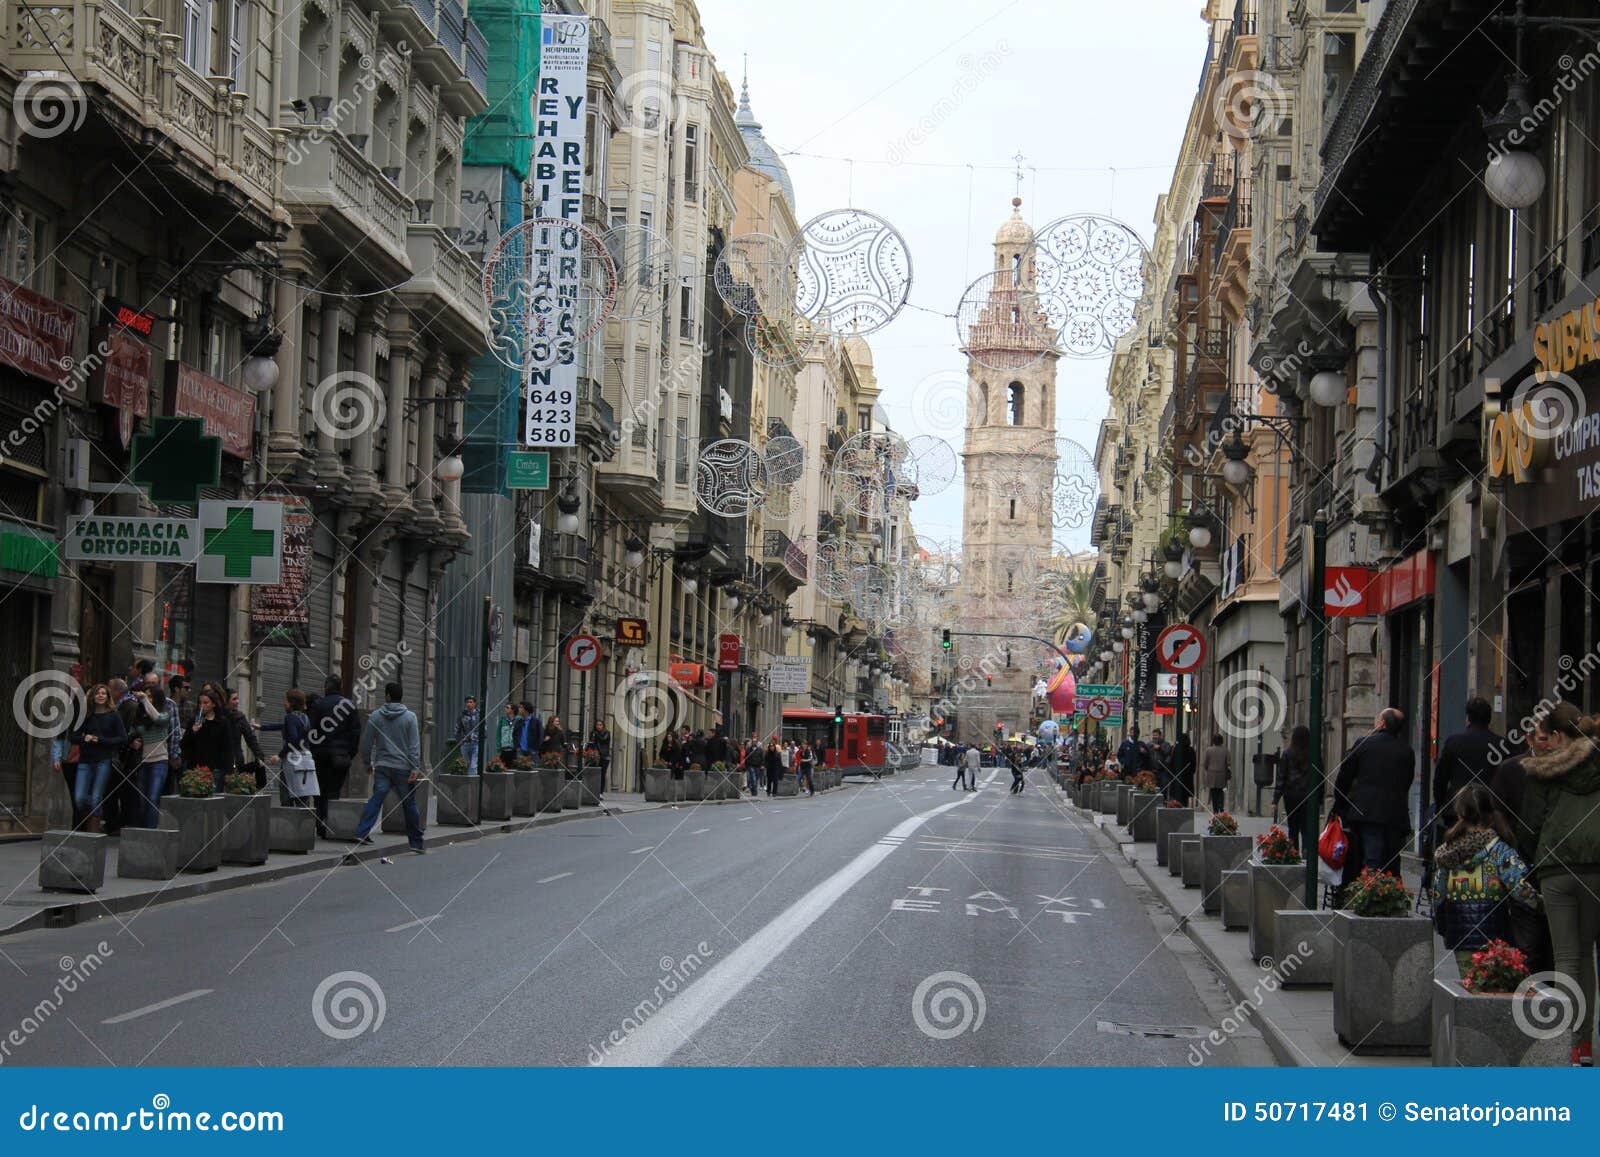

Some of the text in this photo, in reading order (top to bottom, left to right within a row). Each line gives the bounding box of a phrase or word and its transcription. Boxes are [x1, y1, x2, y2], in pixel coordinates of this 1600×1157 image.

[558, 96, 583, 365] Y REFORMAS
[530, 390, 572, 405] 649
[530, 409, 572, 424] 423
[530, 428, 571, 443] 580
[1489, 401, 1534, 484] ORO
[1554, 412, 1600, 460] COMPR
[76, 521, 190, 539] FARMACIA
[81, 539, 181, 556] ORTOPEDIA
[1157, 688, 1191, 696] CARN
[907, 886, 1107, 909] TAXI
[891, 898, 1093, 924] EMT
